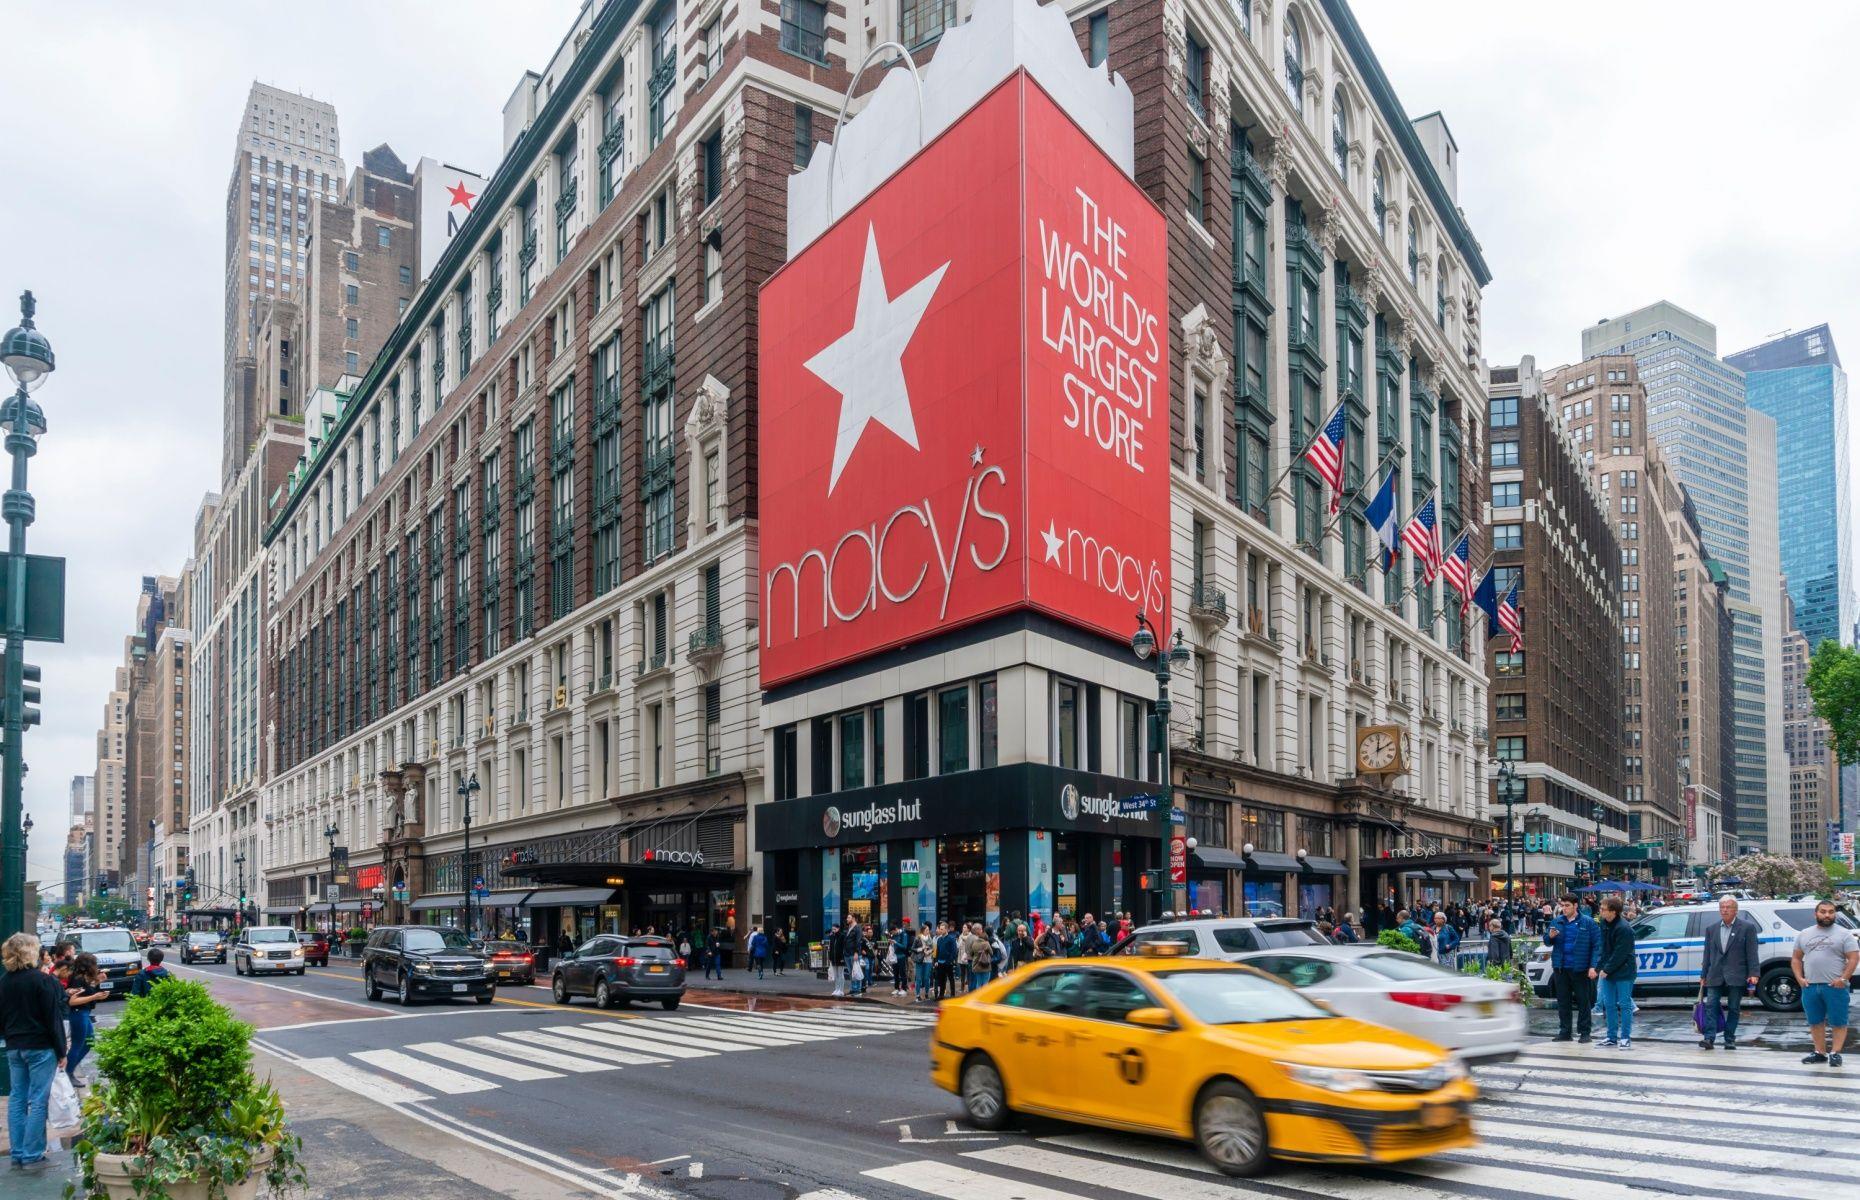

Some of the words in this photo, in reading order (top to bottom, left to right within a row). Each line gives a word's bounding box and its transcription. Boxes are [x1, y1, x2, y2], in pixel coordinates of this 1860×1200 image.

[1075, 186, 1128, 281] THE
[1039, 217, 1159, 364] WORLD'S
[1042, 286, 1158, 418] LARGEST
[1063, 372, 1144, 473] STORE
[842, 802, 896, 832] sunglass
[898, 798, 922, 822] hut
[1081, 792, 1130, 823] sungla
[1122, 801, 1138, 810] West
[1150, 799, 1157, 807] St
[655, 849, 704, 866] macy's
